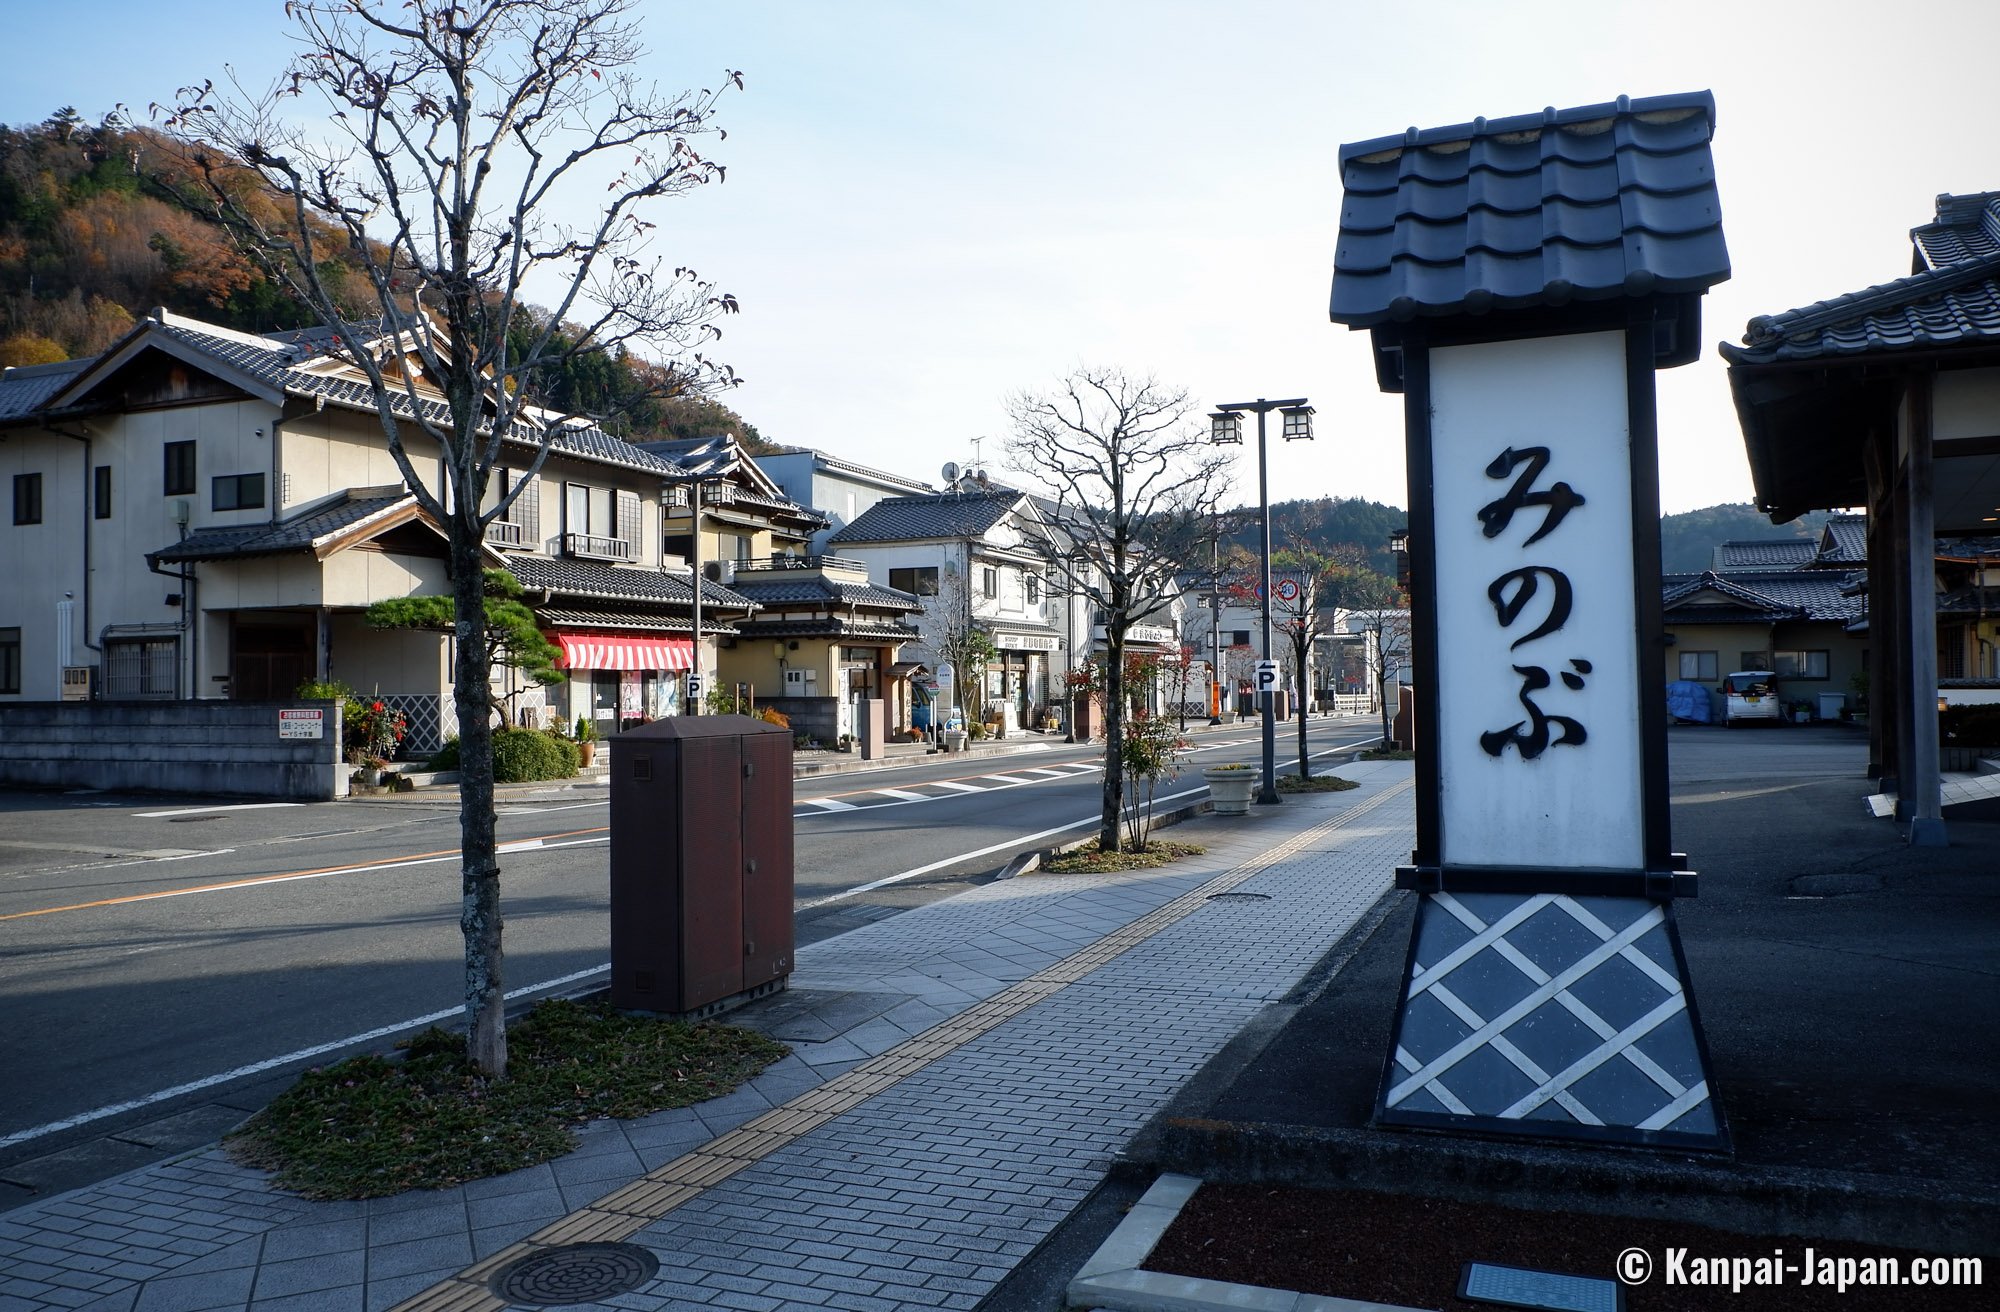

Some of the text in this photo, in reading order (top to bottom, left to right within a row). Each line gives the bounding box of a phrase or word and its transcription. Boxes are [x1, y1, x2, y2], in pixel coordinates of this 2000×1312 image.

[1477, 446, 1592, 760] みのぶ
[689, 682, 700, 696] P
[1259, 671, 1275, 690] P
